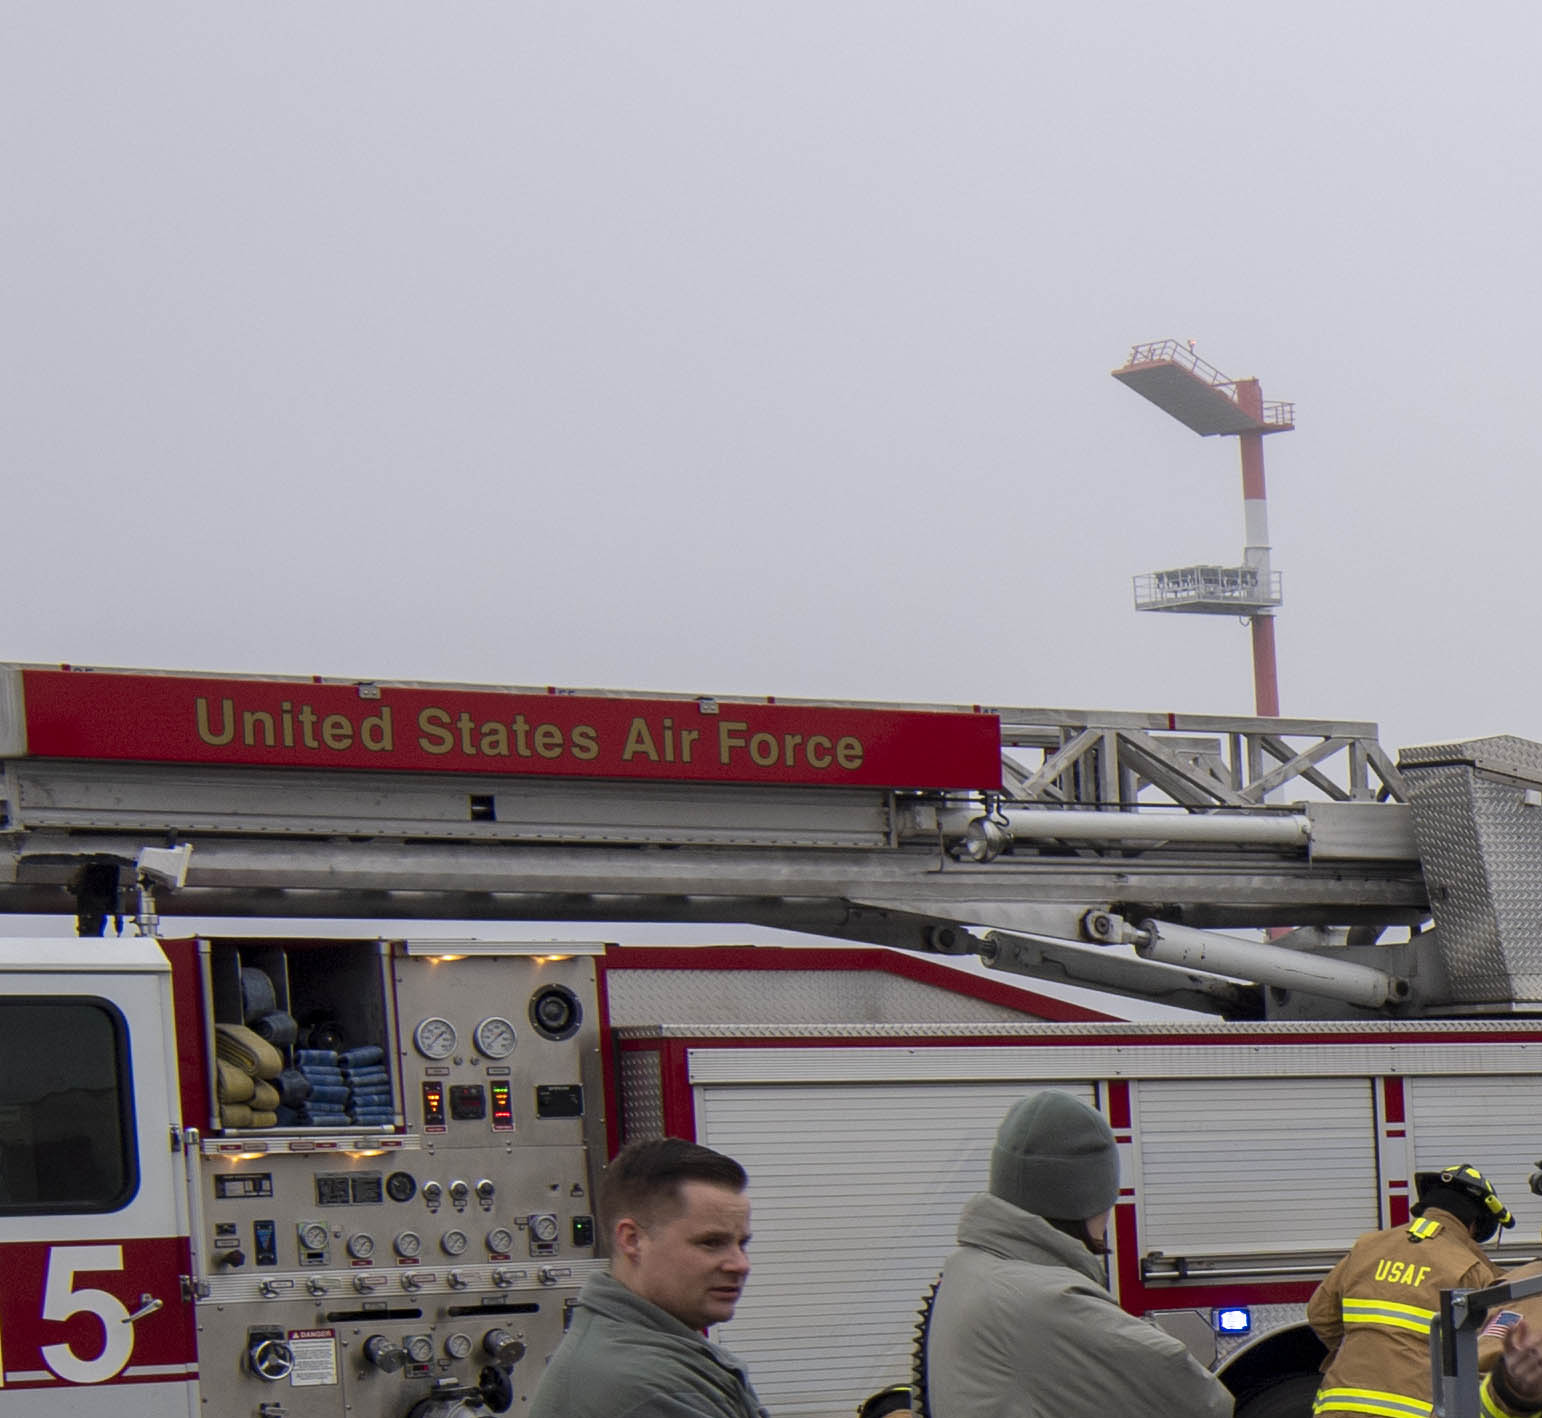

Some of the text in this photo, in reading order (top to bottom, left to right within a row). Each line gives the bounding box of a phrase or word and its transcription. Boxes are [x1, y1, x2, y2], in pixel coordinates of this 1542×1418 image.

[194, 696, 865, 771] United States Air Force
[1374, 1259, 1431, 1288] USAF
